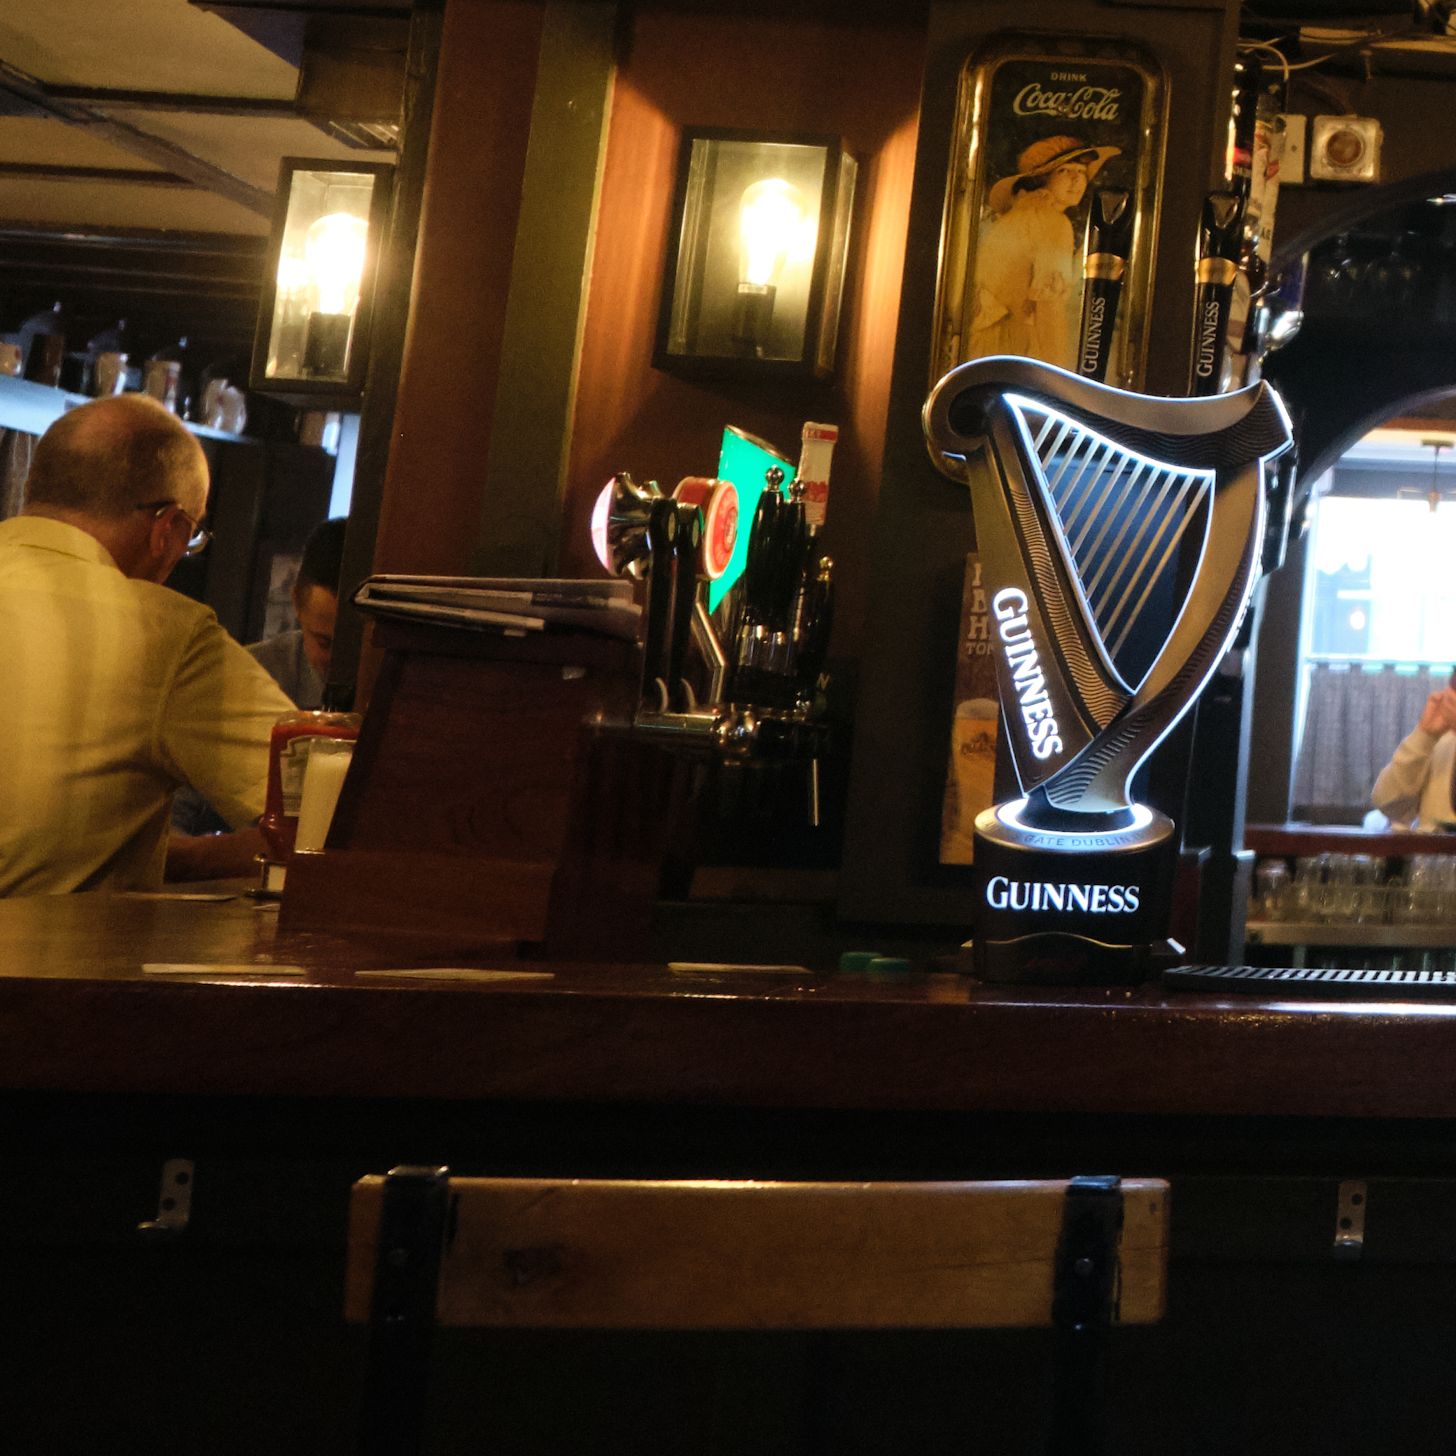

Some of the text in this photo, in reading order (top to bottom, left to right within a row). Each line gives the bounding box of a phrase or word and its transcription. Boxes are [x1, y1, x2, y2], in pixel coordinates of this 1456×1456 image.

[1012, 82, 1121, 121] Coca-Cola
[1050, 72, 1087, 82] DRINK
[1082, 296, 1106, 373] GUINNESS
[1197, 301, 1220, 377] GUINNESS
[992, 587, 1063, 760] GUINNESS
[986, 876, 1140, 914] GUINNESS
